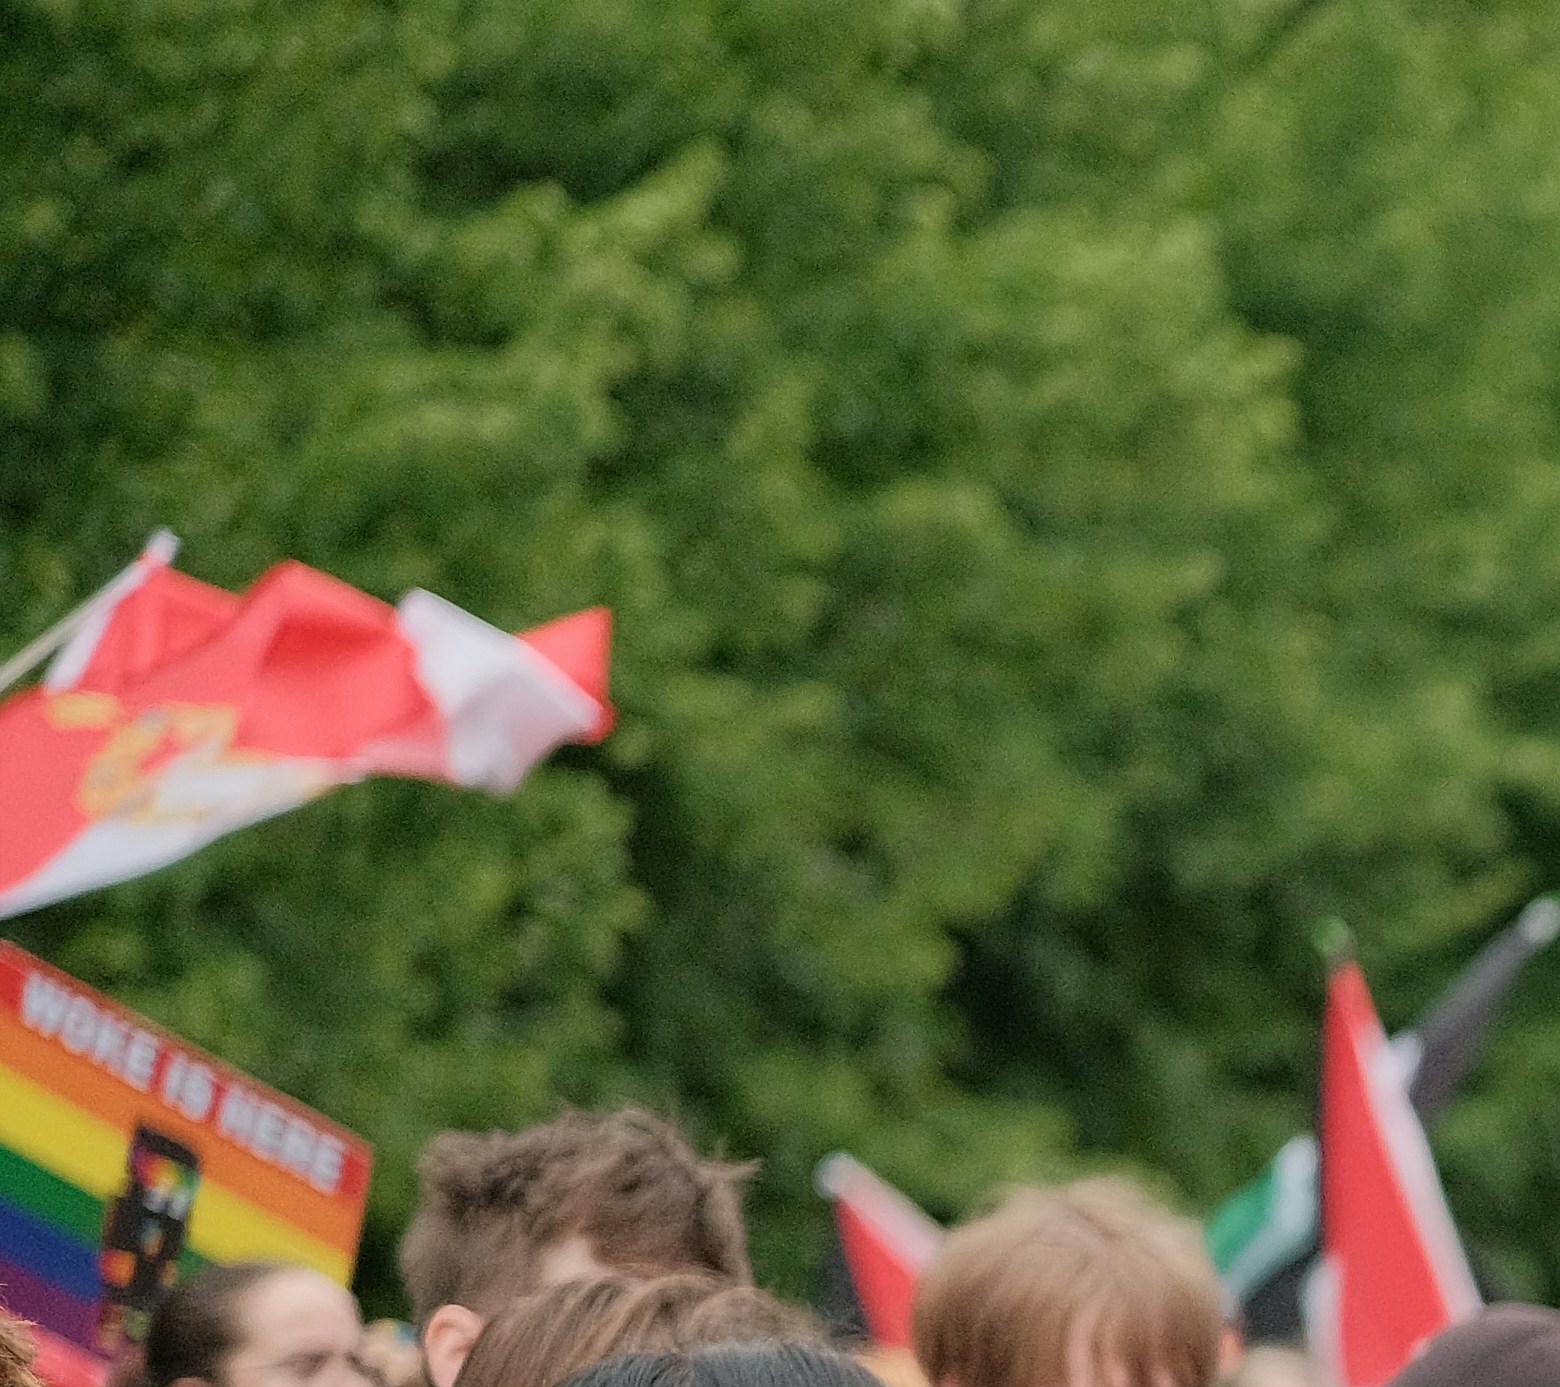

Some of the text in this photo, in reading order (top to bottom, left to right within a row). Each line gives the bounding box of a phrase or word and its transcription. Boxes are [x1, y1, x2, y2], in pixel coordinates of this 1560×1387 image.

[22, 971, 345, 1194] WOKE IS HERE
